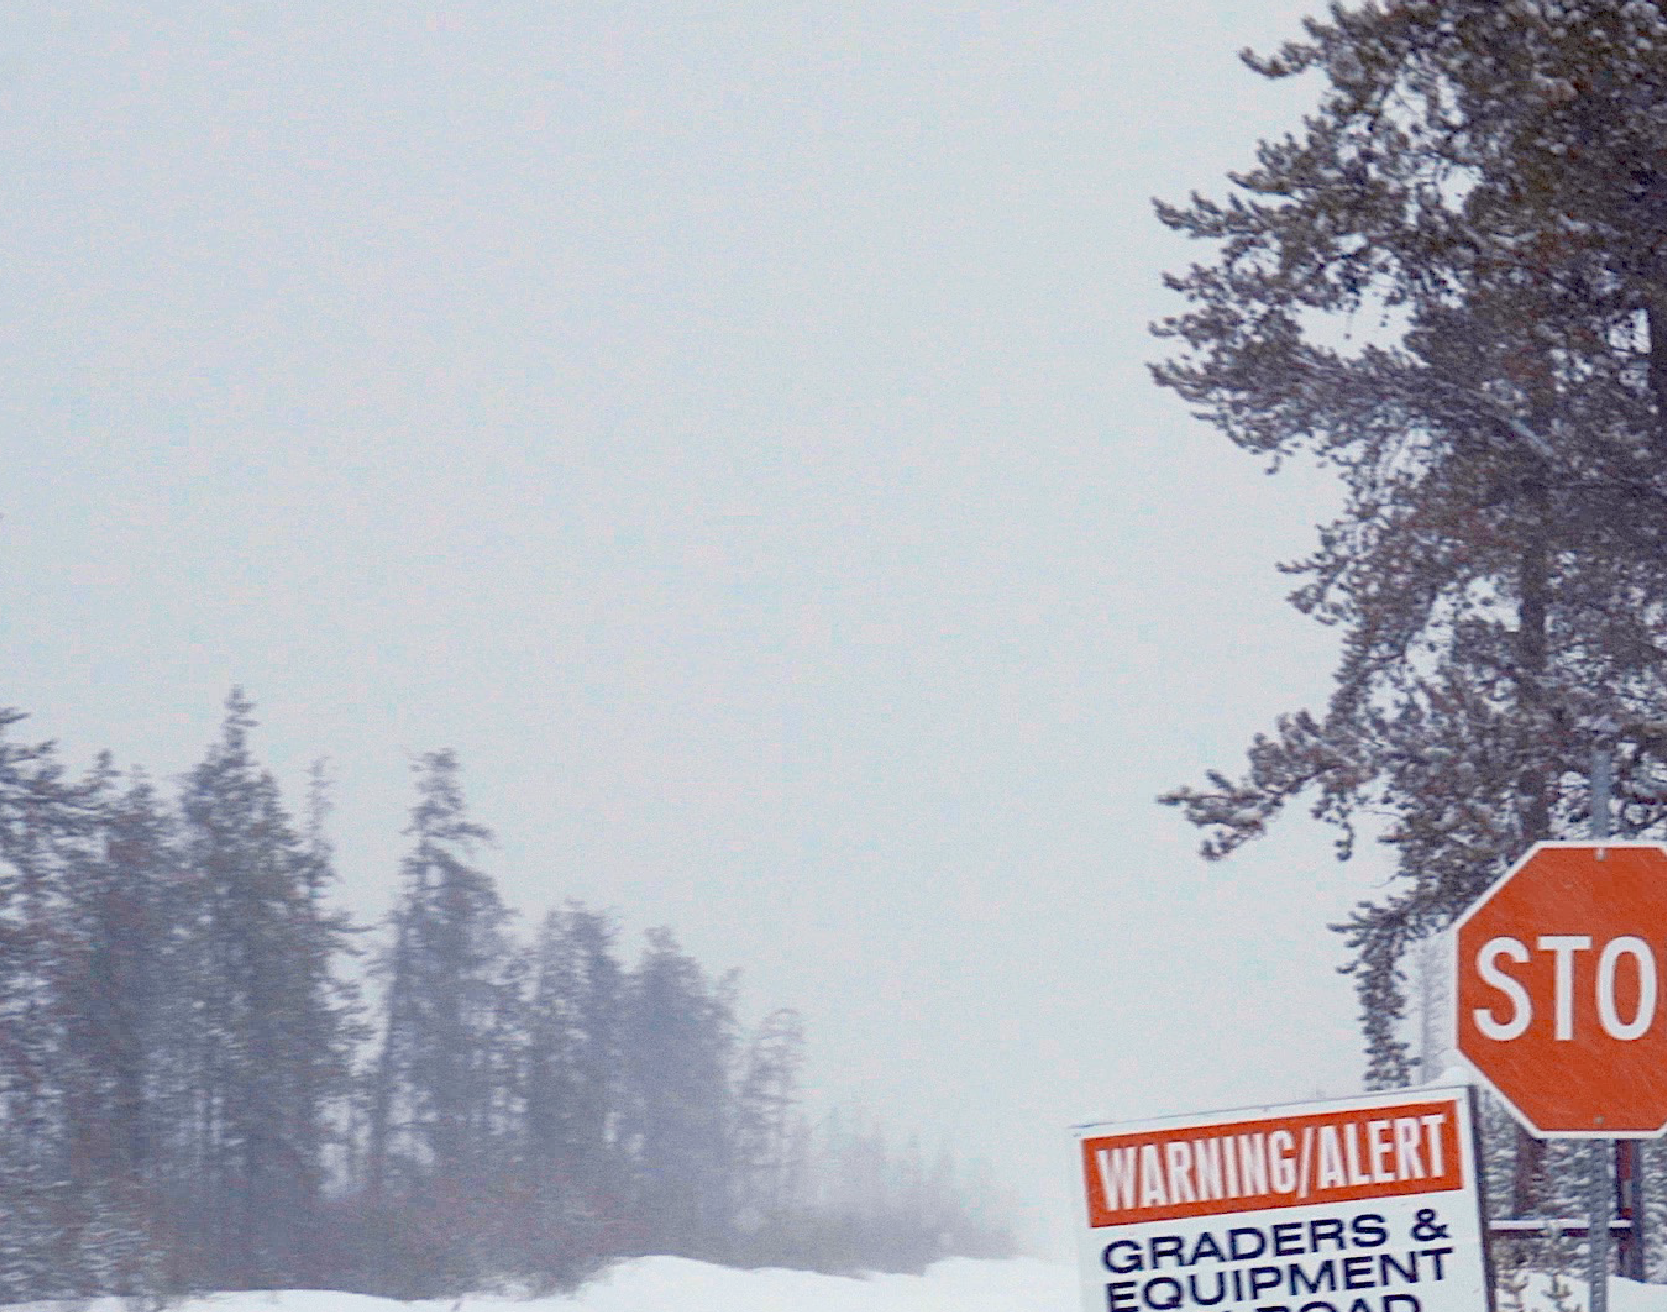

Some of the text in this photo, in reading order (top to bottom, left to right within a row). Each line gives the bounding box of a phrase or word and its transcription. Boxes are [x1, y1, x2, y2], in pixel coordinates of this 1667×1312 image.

[1098, 1114, 1447, 1212] WARNING/ALERT
[1102, 1208, 1451, 1274] GRADERS &
